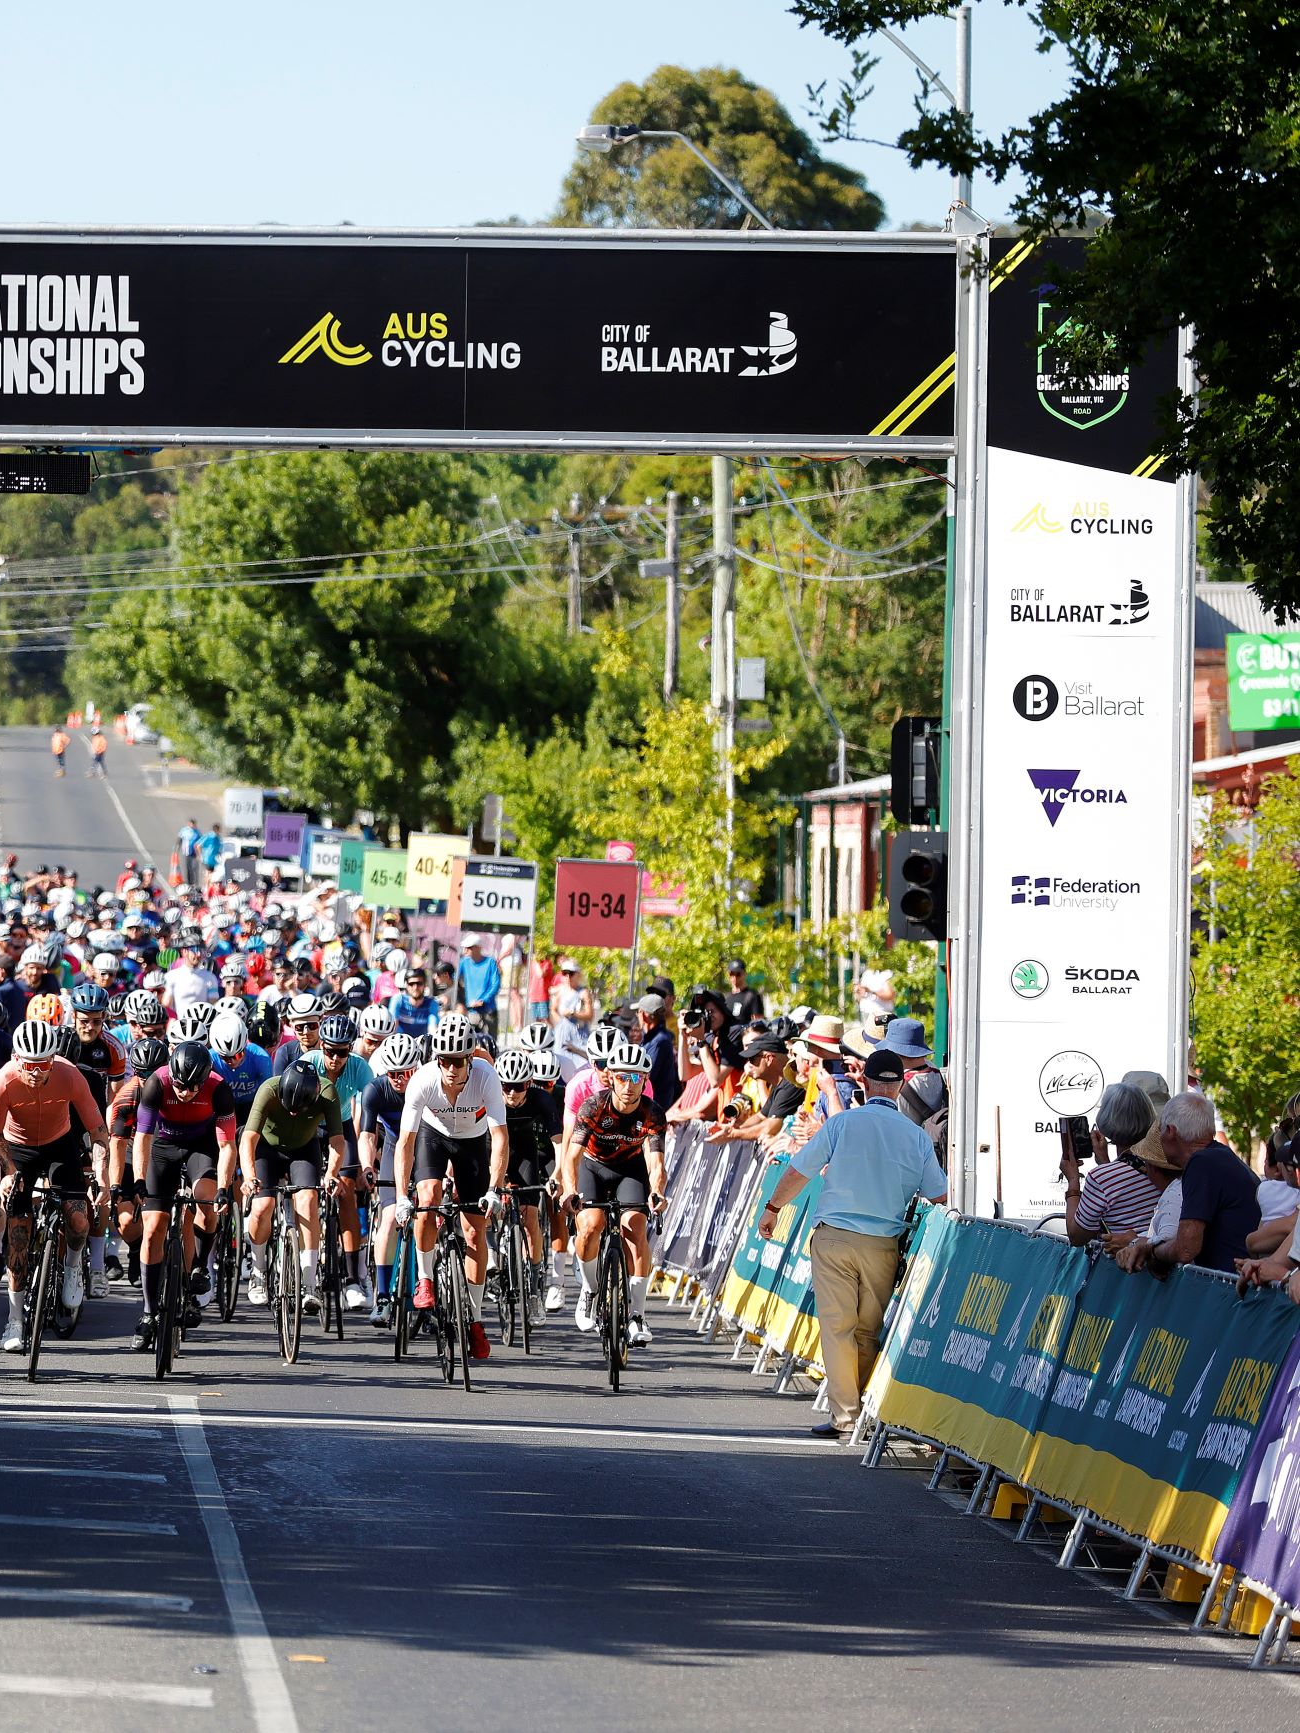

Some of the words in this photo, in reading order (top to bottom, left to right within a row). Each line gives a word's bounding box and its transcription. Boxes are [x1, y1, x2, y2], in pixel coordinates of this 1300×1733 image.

[382, 312, 448, 340] AUS
[601, 324, 630, 343] CITY
[635, 325, 651, 343] OF
[381, 340, 522, 369] CYCLING
[601, 346, 735, 374] BALLARAT
[1061, 395, 1093, 404] BALLARAT,
[1093, 395, 1104, 404] VIC
[1072, 502, 1110, 517] AUS
[1070, 518, 1154, 535] CYCLING
[1010, 588, 1031, 601] CITY
[1034, 588, 1045, 601] OF
[1010, 604, 1105, 623] BALLARAT
[1064, 681, 1093, 695] Visit
[1064, 696, 1145, 717] Ballarat
[1034, 787, 1128, 804] VICTORIA
[317, 853, 340, 866] 100
[415, 857, 453, 878] 40-4
[1053, 877, 1141, 894] Federation
[473, 889, 522, 911] 50m
[568, 891, 627, 920] 19-34
[1052, 896, 1119, 911] University
[1064, 965, 1141, 982] ŠKODA
[1072, 986, 1133, 995] BALLARAT
[1046, 1072, 1099, 1094] McCafé
[1028, 1199, 1066, 1207] Australian
[954, 1271, 1012, 1336] NATIONAL
[941, 1328, 992, 1374] CHAMPIONSHIPS
[1129, 1327, 1190, 1398] NATIONAL
[1114, 1387, 1167, 1439] CHAMPIONSHIPS
